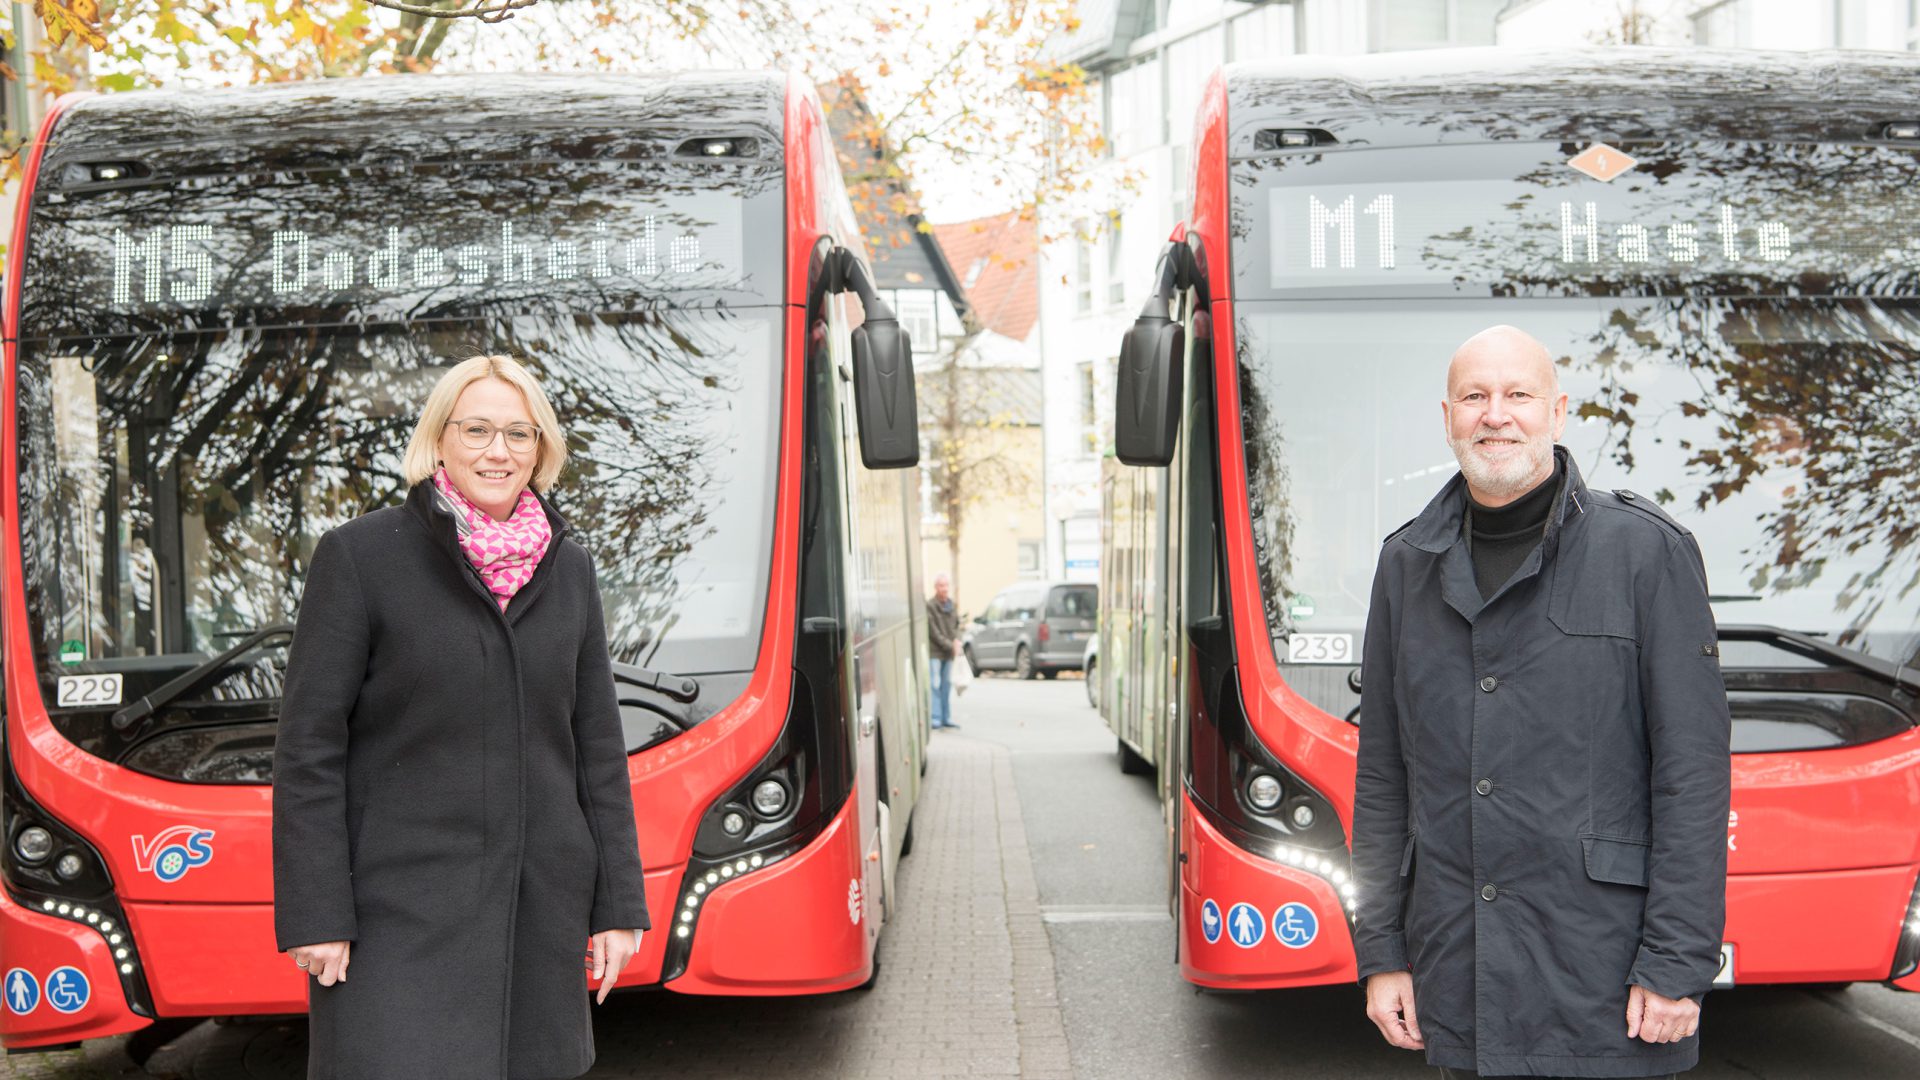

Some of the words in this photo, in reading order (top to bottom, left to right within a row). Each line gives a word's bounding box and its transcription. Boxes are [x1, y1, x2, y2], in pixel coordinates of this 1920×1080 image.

[1309, 194, 1394, 269] M1
[1561, 201, 1790, 263] Haste
[113, 225, 213, 303] M5
[273, 215, 700, 293] Dodesheide
[1294, 636, 1348, 660] 239
[62, 677, 118, 703] 229
